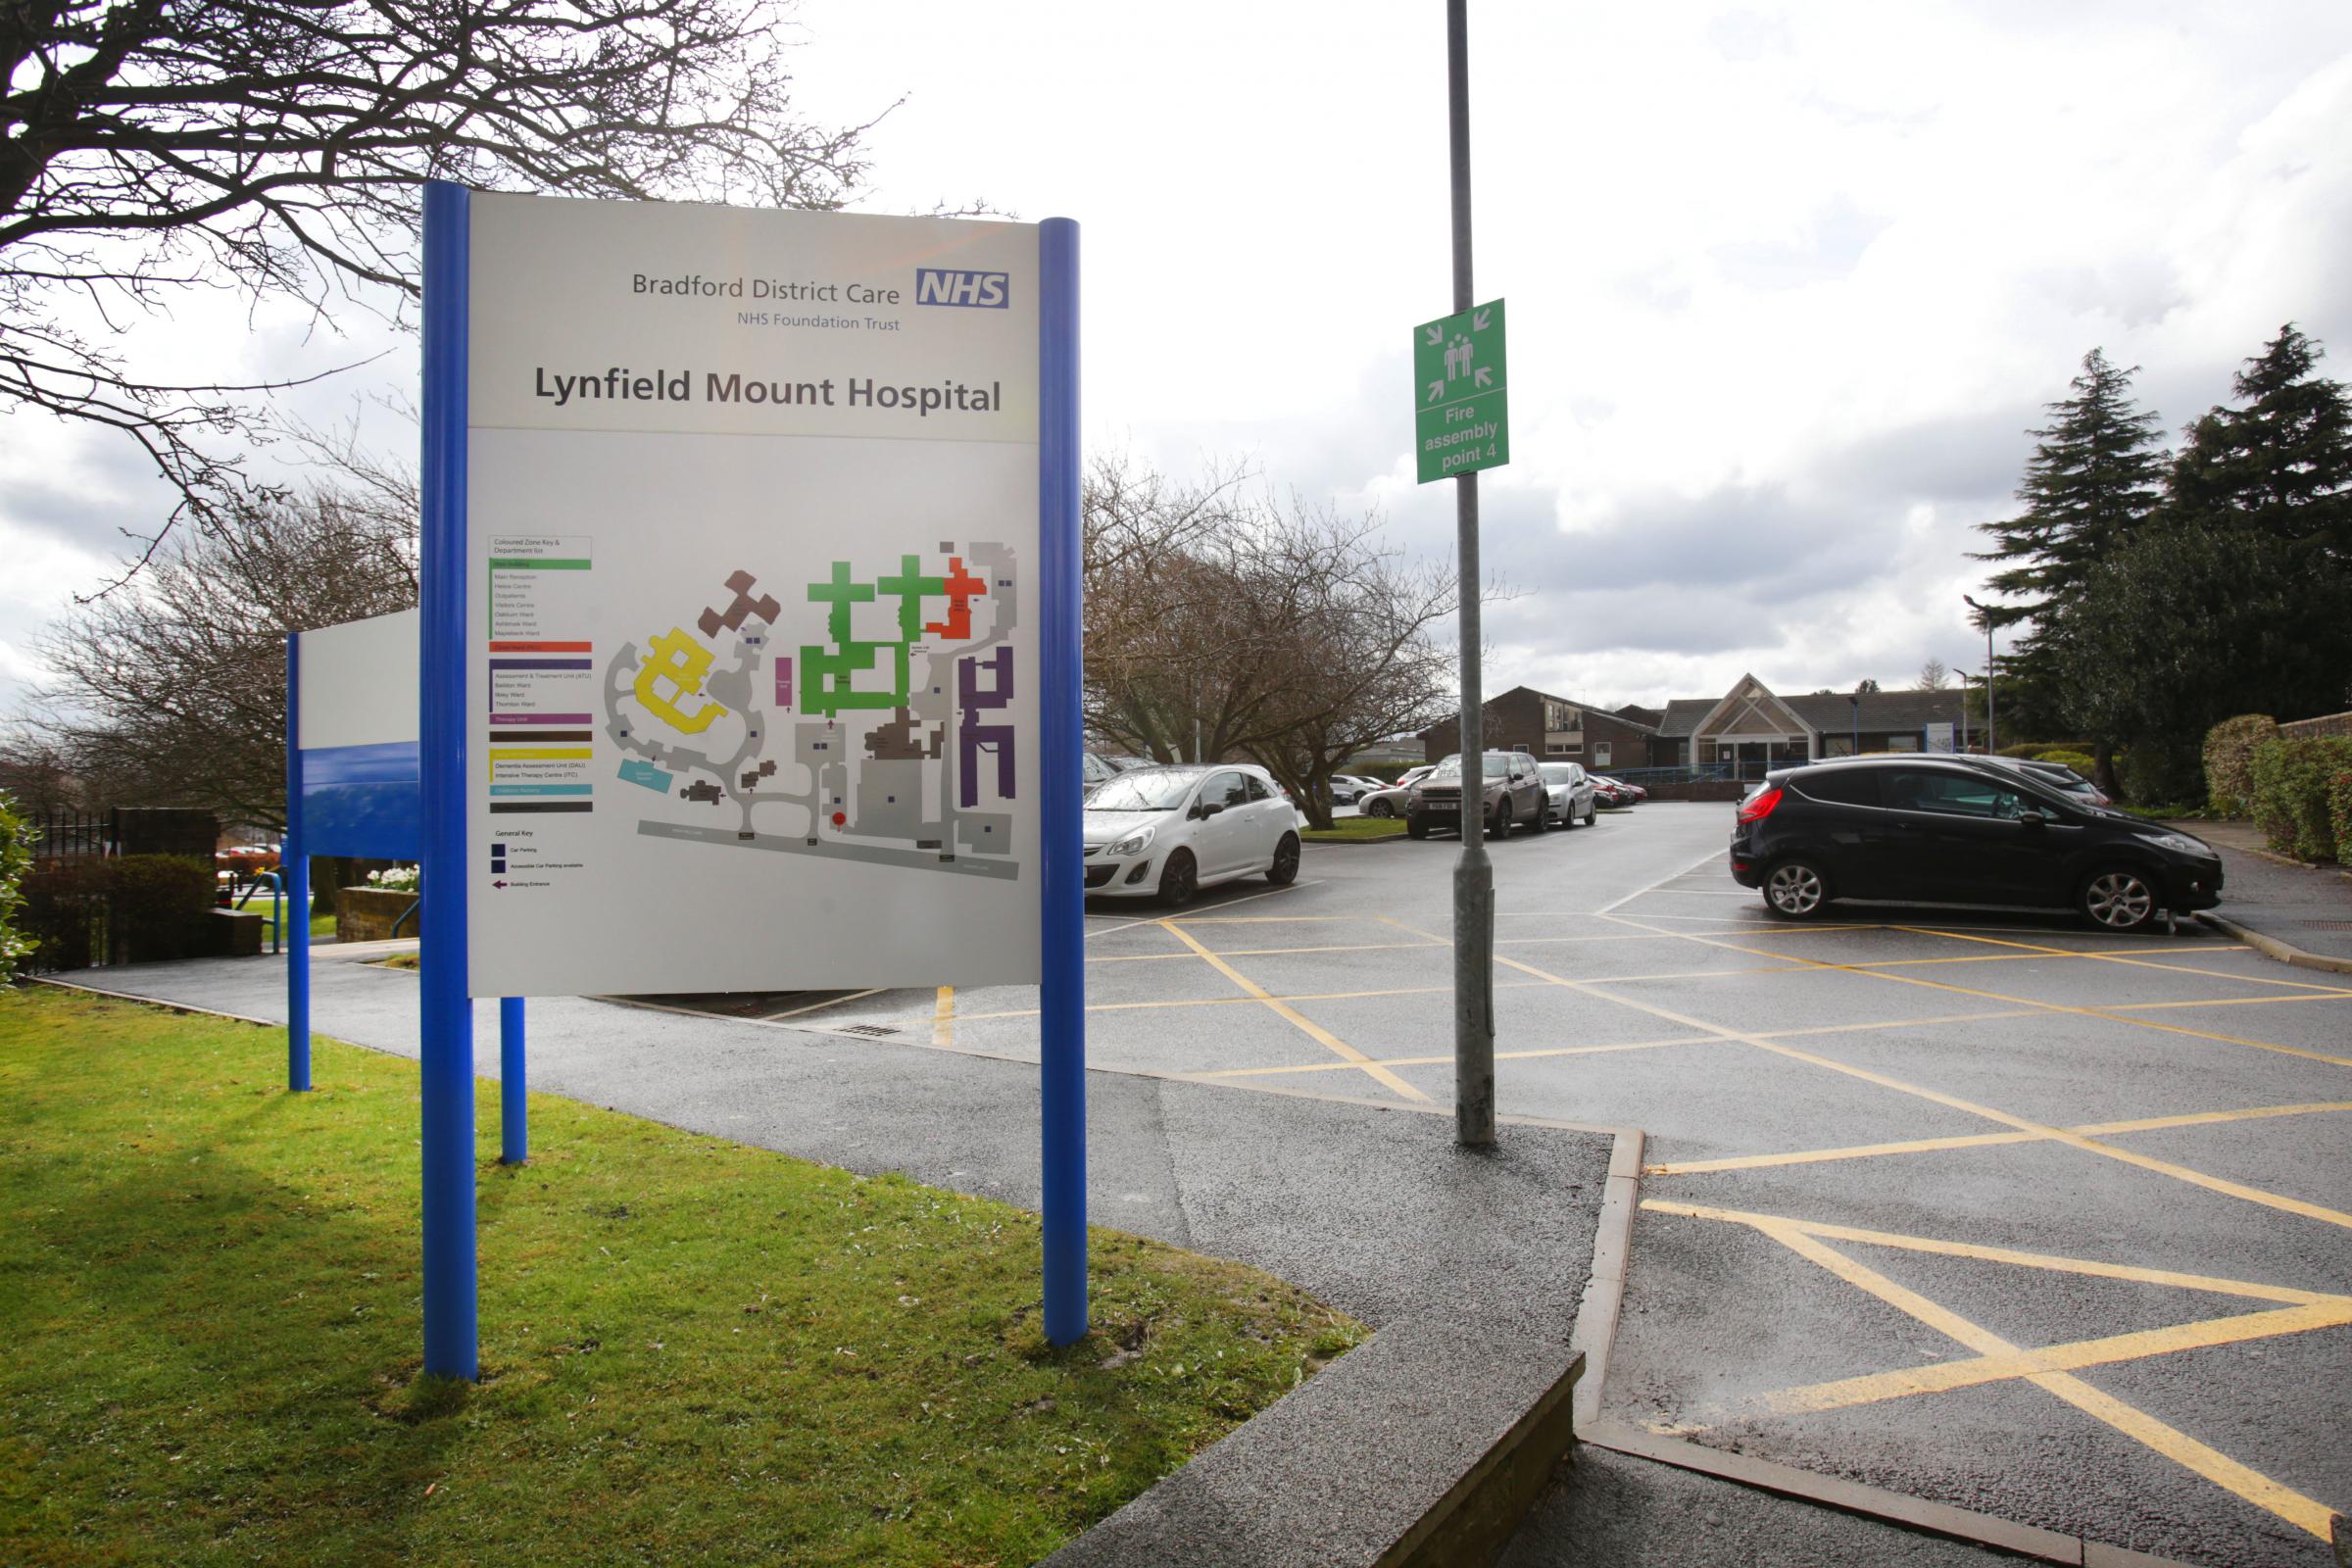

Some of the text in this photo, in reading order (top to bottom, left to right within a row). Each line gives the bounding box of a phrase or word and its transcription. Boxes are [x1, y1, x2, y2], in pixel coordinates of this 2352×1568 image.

[633, 273, 901, 305] Bradford District Care
[917, 271, 1008, 306] NHS
[737, 312, 901, 331] NHS Foundation Trust
[535, 367, 1002, 416] Lynfield Mount Hospital
[1446, 407, 1475, 424] Fire
[1425, 421, 1498, 451] assembly
[1442, 443, 1496, 472] point 4
